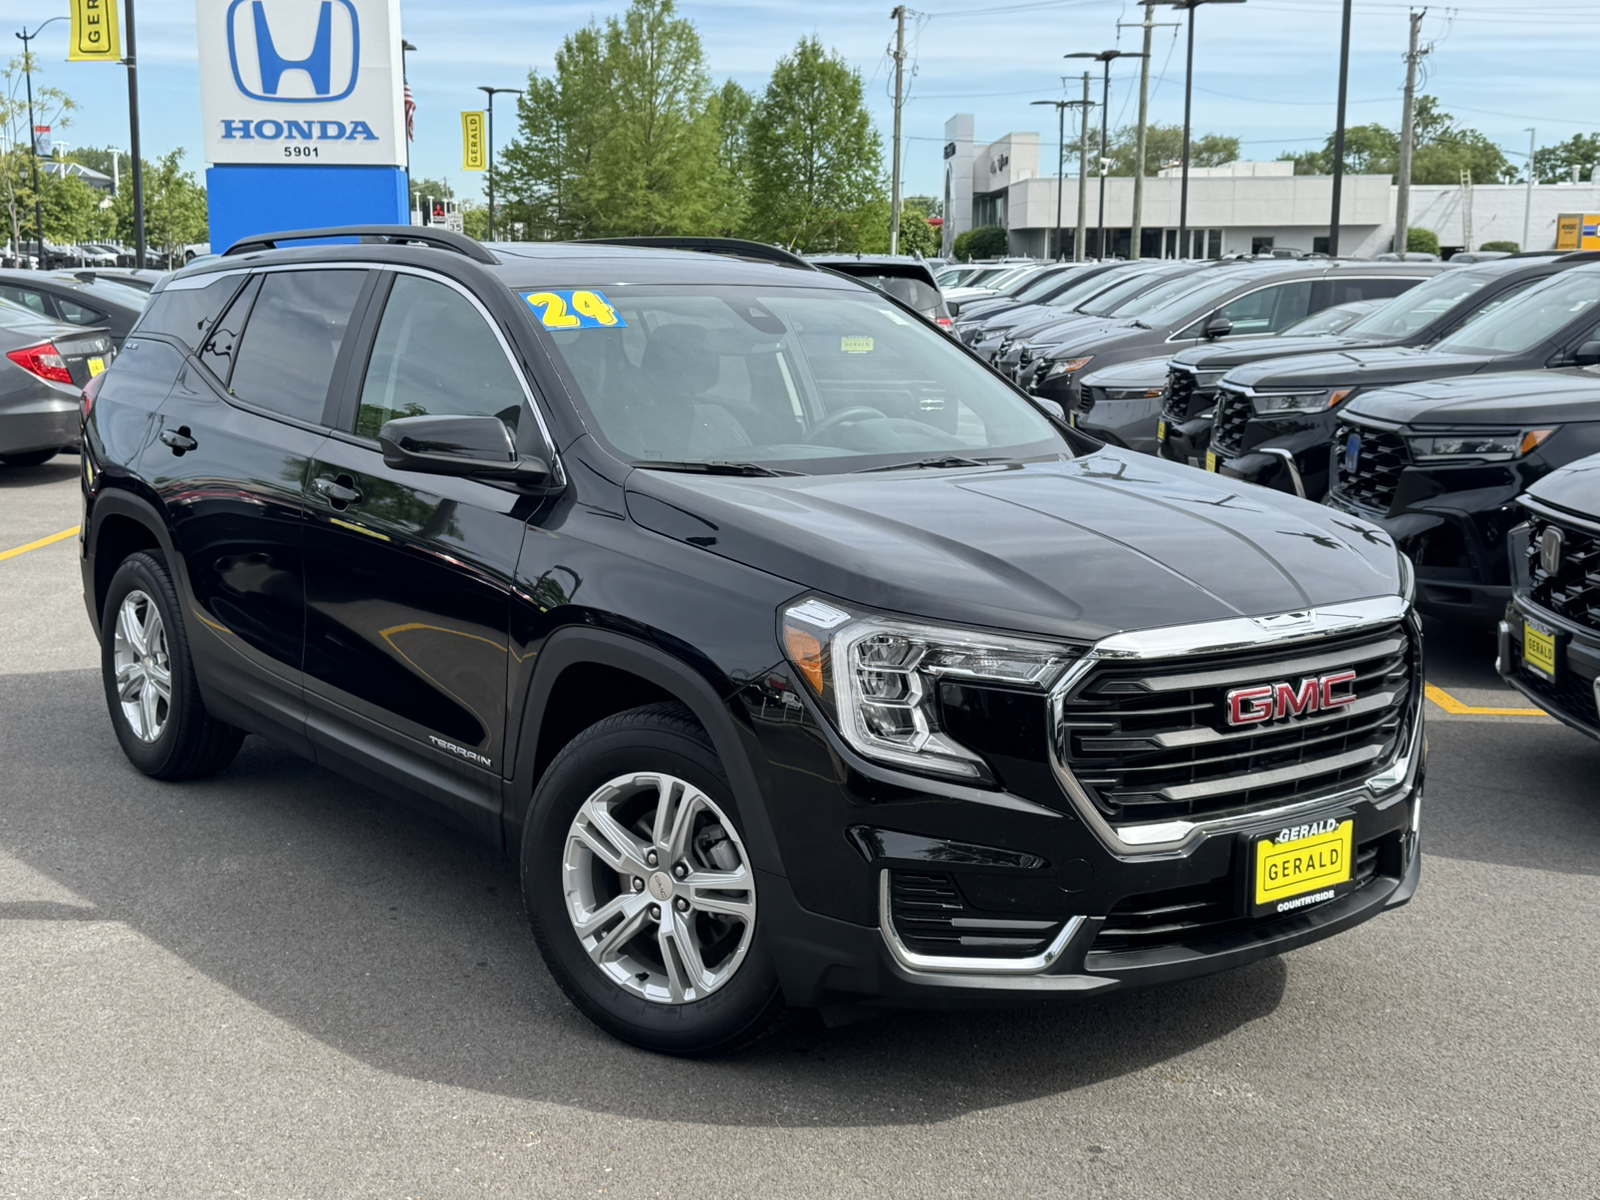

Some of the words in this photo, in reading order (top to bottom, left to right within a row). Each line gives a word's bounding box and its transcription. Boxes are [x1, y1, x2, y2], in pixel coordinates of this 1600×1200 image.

[220, 119, 379, 140] HONDA
[470, 118, 478, 163] GERALD
[284, 146, 319, 157] 5901
[450, 223, 462, 231] 35
[527, 291, 618, 328] 24
[1528, 638, 1552, 660] GERALD
[1227, 670, 1357, 726] GMC
[429, 735, 491, 767] TERRAIN
[1278, 818, 1337, 842] GERALD
[1268, 848, 1339, 881] GERALD
[654, 875, 668, 899] GMC
[1277, 889, 1335, 913] COUNTRYSIDE
